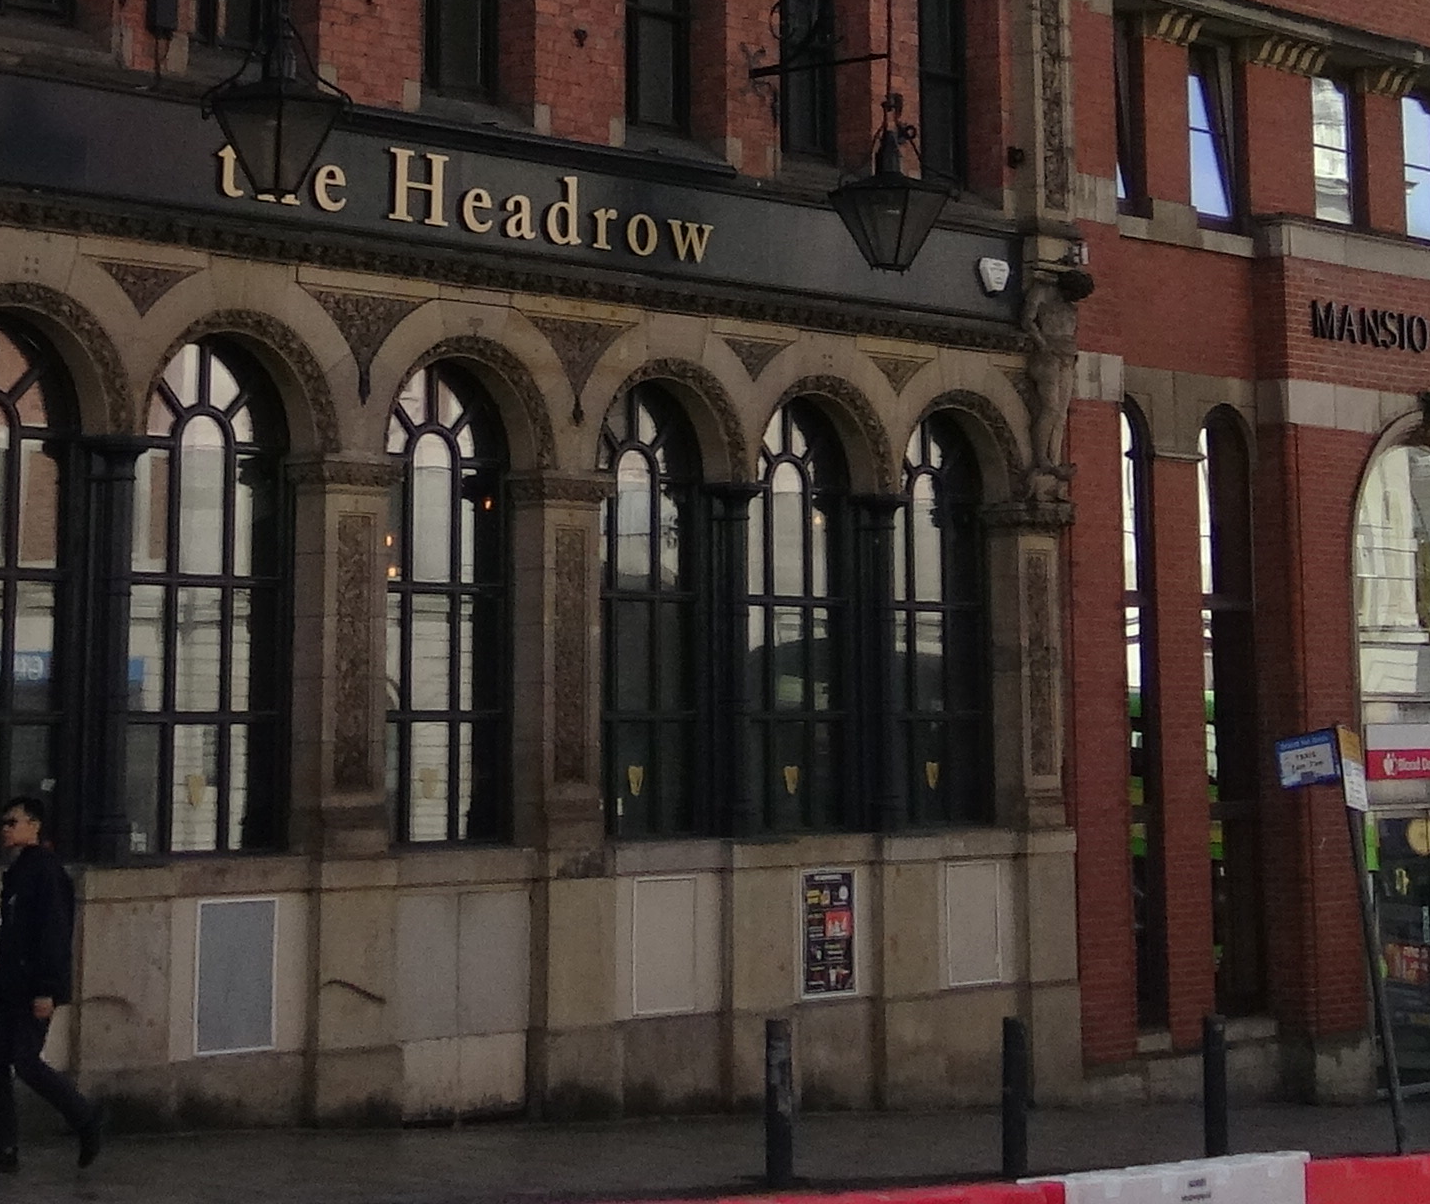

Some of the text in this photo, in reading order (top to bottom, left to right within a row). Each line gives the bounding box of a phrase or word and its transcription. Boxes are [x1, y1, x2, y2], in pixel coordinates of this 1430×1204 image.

[217, 143, 715, 264] te Headrow
[1310, 299, 1429, 353] MANSIO
